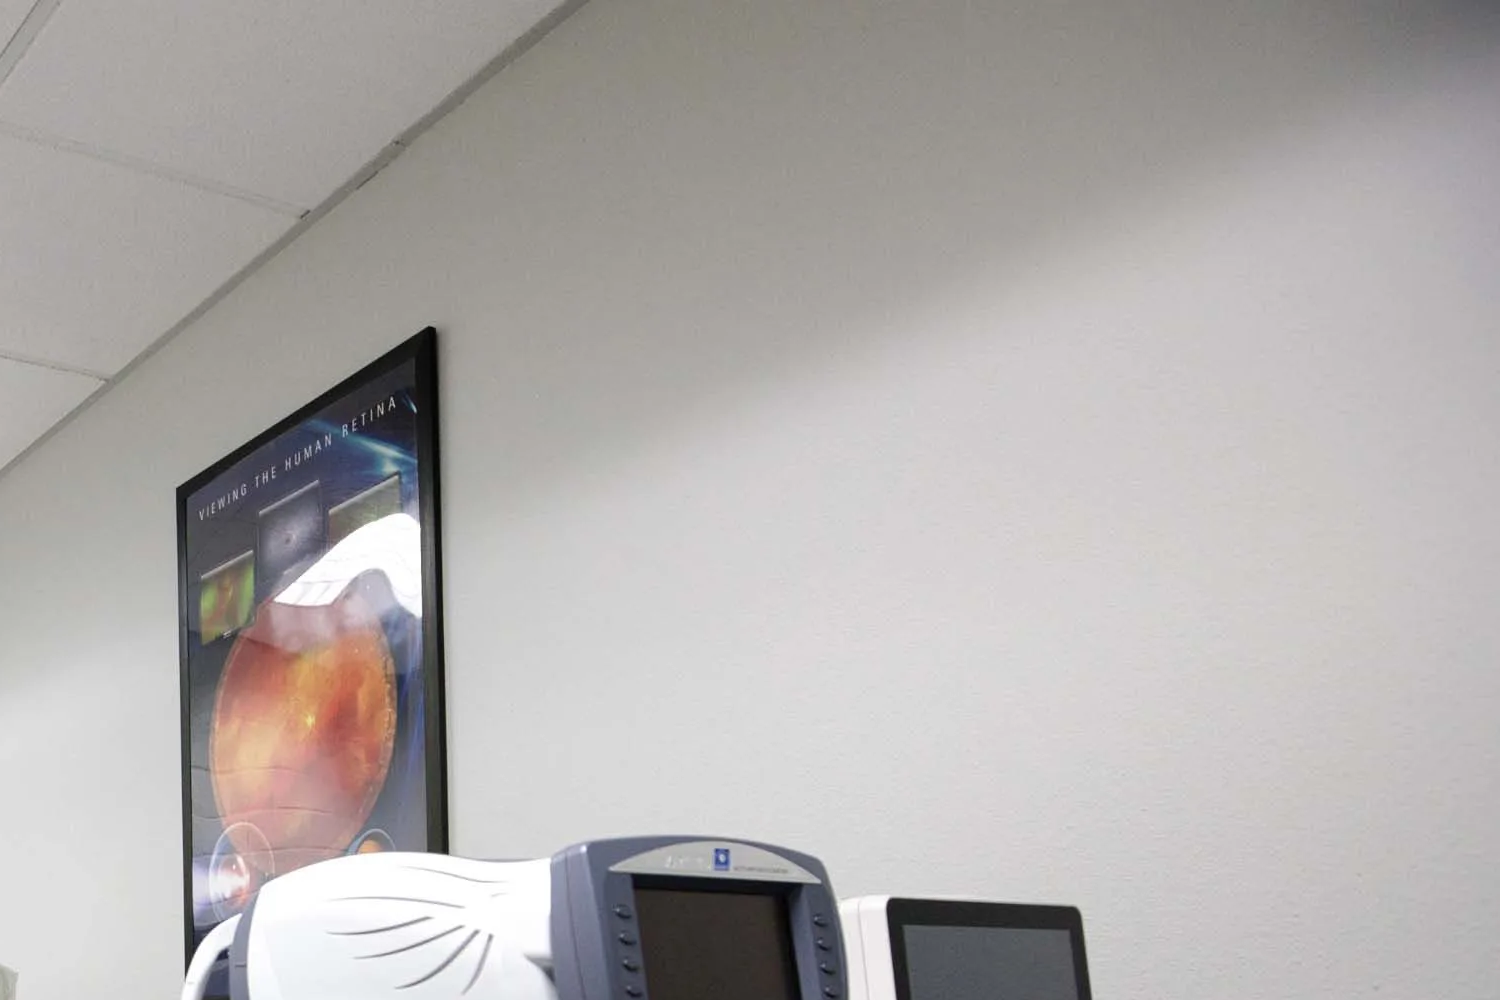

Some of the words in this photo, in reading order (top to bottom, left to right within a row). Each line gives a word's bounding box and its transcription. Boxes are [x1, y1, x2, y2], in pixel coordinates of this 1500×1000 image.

[199, 483, 247, 521] VIEWING
[255, 466, 277, 489] THE
[285, 433, 332, 472] HUMAN
[342, 396, 396, 438] RETINA
